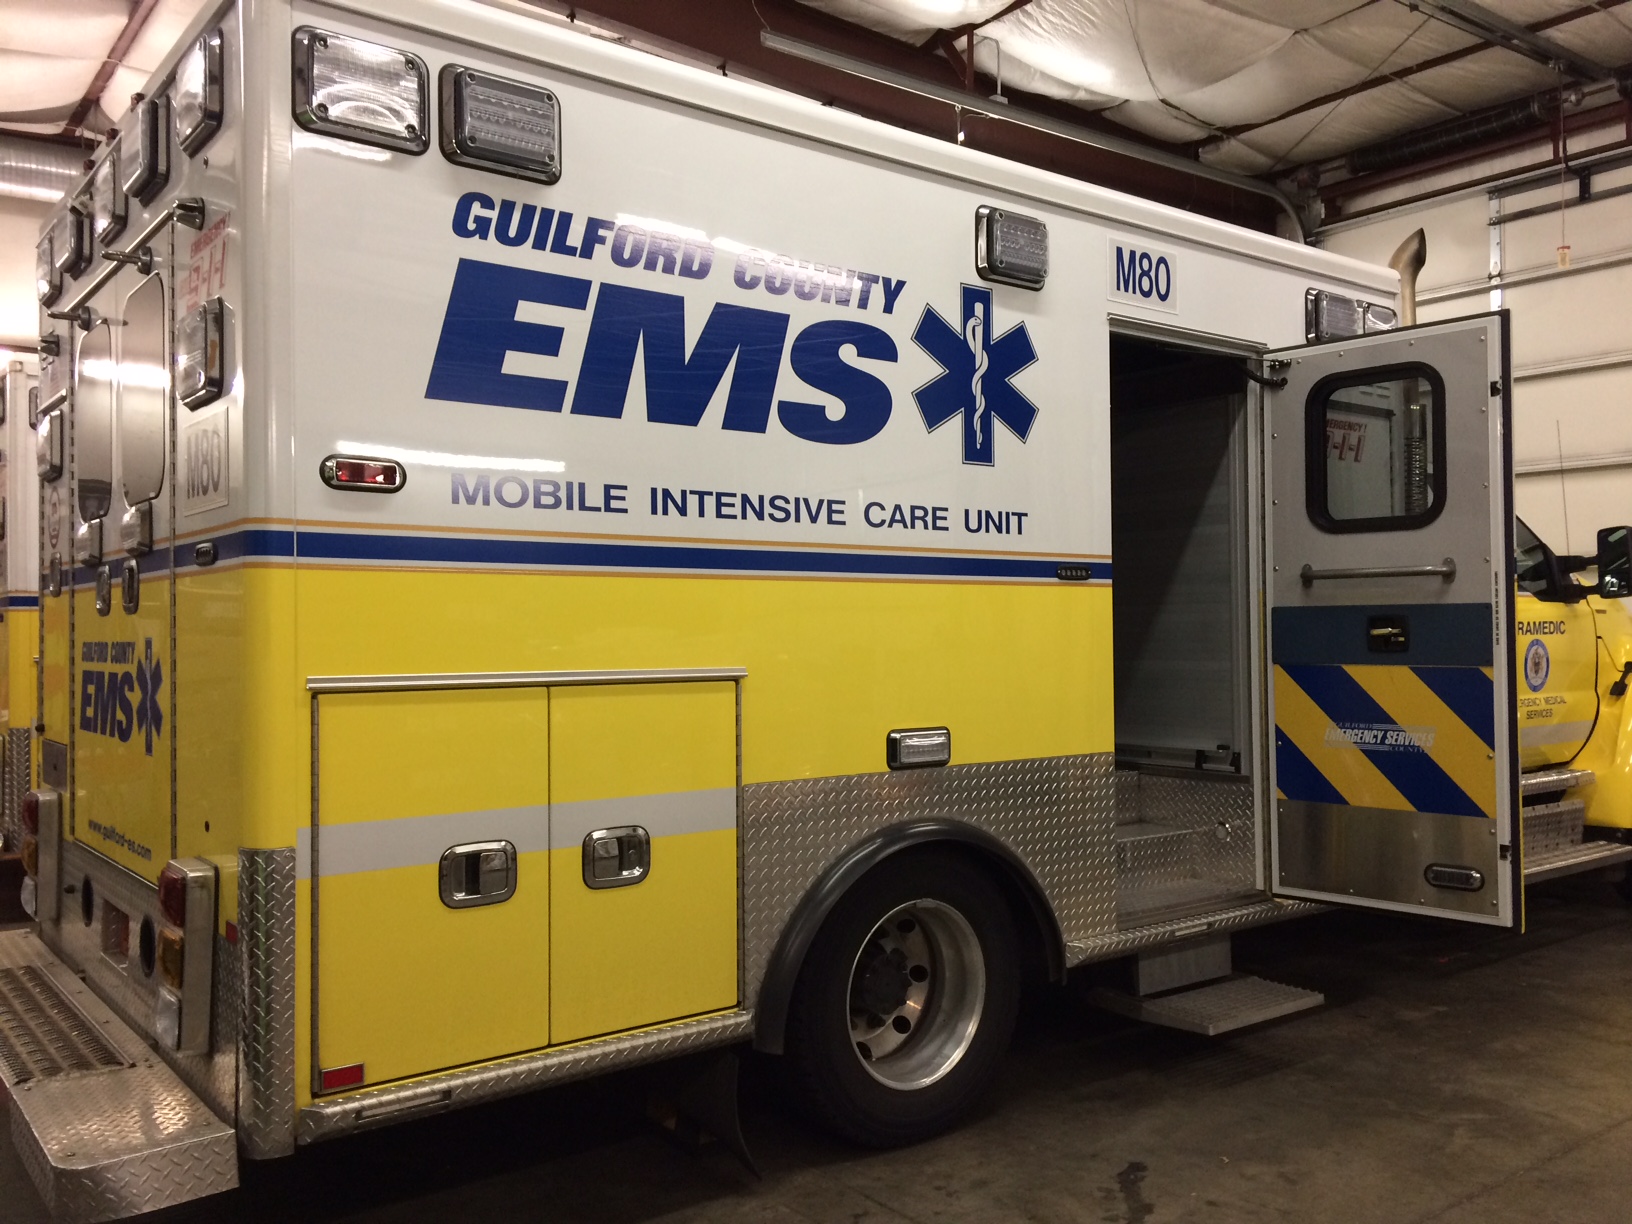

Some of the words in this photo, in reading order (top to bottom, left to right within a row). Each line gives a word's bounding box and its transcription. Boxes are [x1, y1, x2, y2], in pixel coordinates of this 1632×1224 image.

[452, 191, 716, 280] GUILFORD
[733, 248, 908, 315] COUNTY
[1115, 246, 1171, 302] M80
[424, 257, 899, 446] EMS
[186, 426, 222, 500] M80
[450, 472, 628, 514] MOBILE
[650, 486, 846, 526] INTENSIVE
[863, 501, 949, 532] CARE
[963, 508, 1028, 536] UNIT
[1517, 620, 1566, 636] RAMEDIC
[79, 669, 135, 743] EMS
[1324, 727, 1384, 744] EMERGENCY
[1384, 730, 1436, 748] SERVICES
